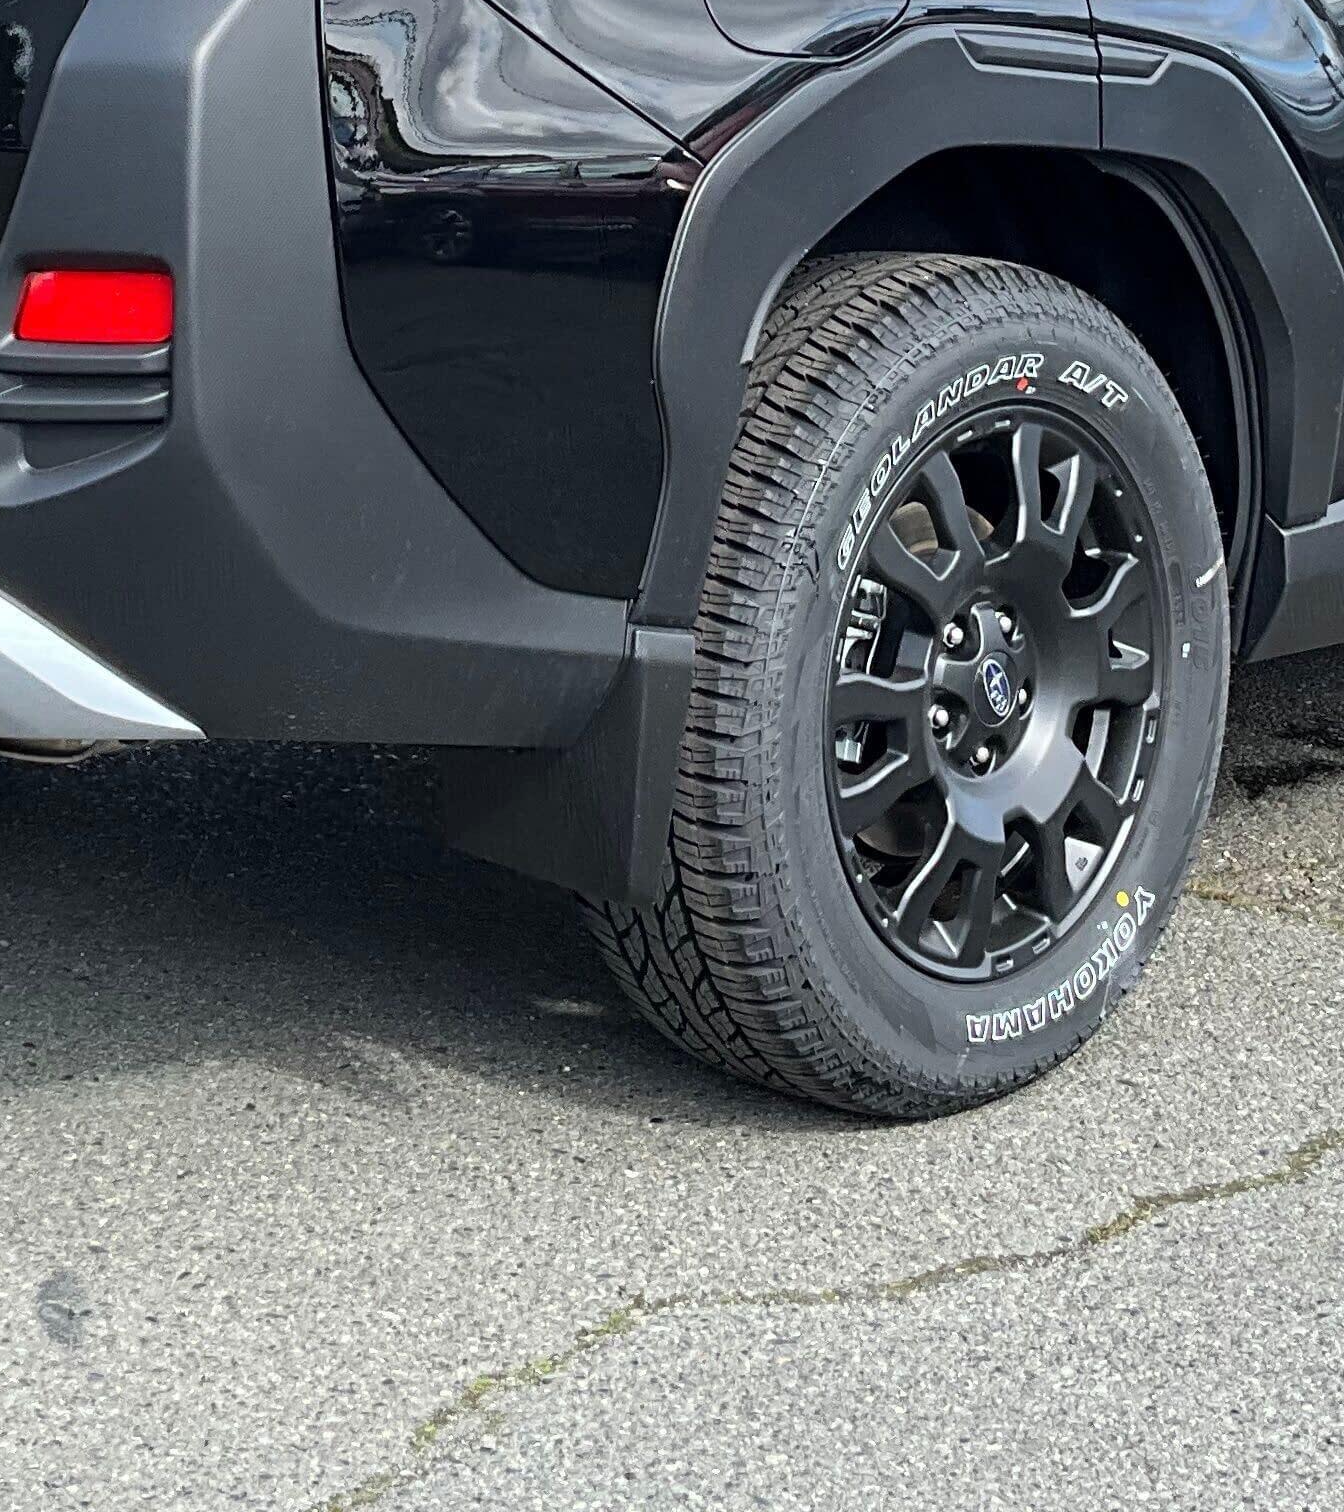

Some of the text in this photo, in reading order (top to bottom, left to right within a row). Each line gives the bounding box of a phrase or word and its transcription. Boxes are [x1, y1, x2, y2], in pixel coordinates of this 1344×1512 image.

[836, 351, 1046, 571] GEOLANDAR
[1057, 358, 1131, 408] A/T
[966, 885, 1156, 1043] YOKOHAMA
